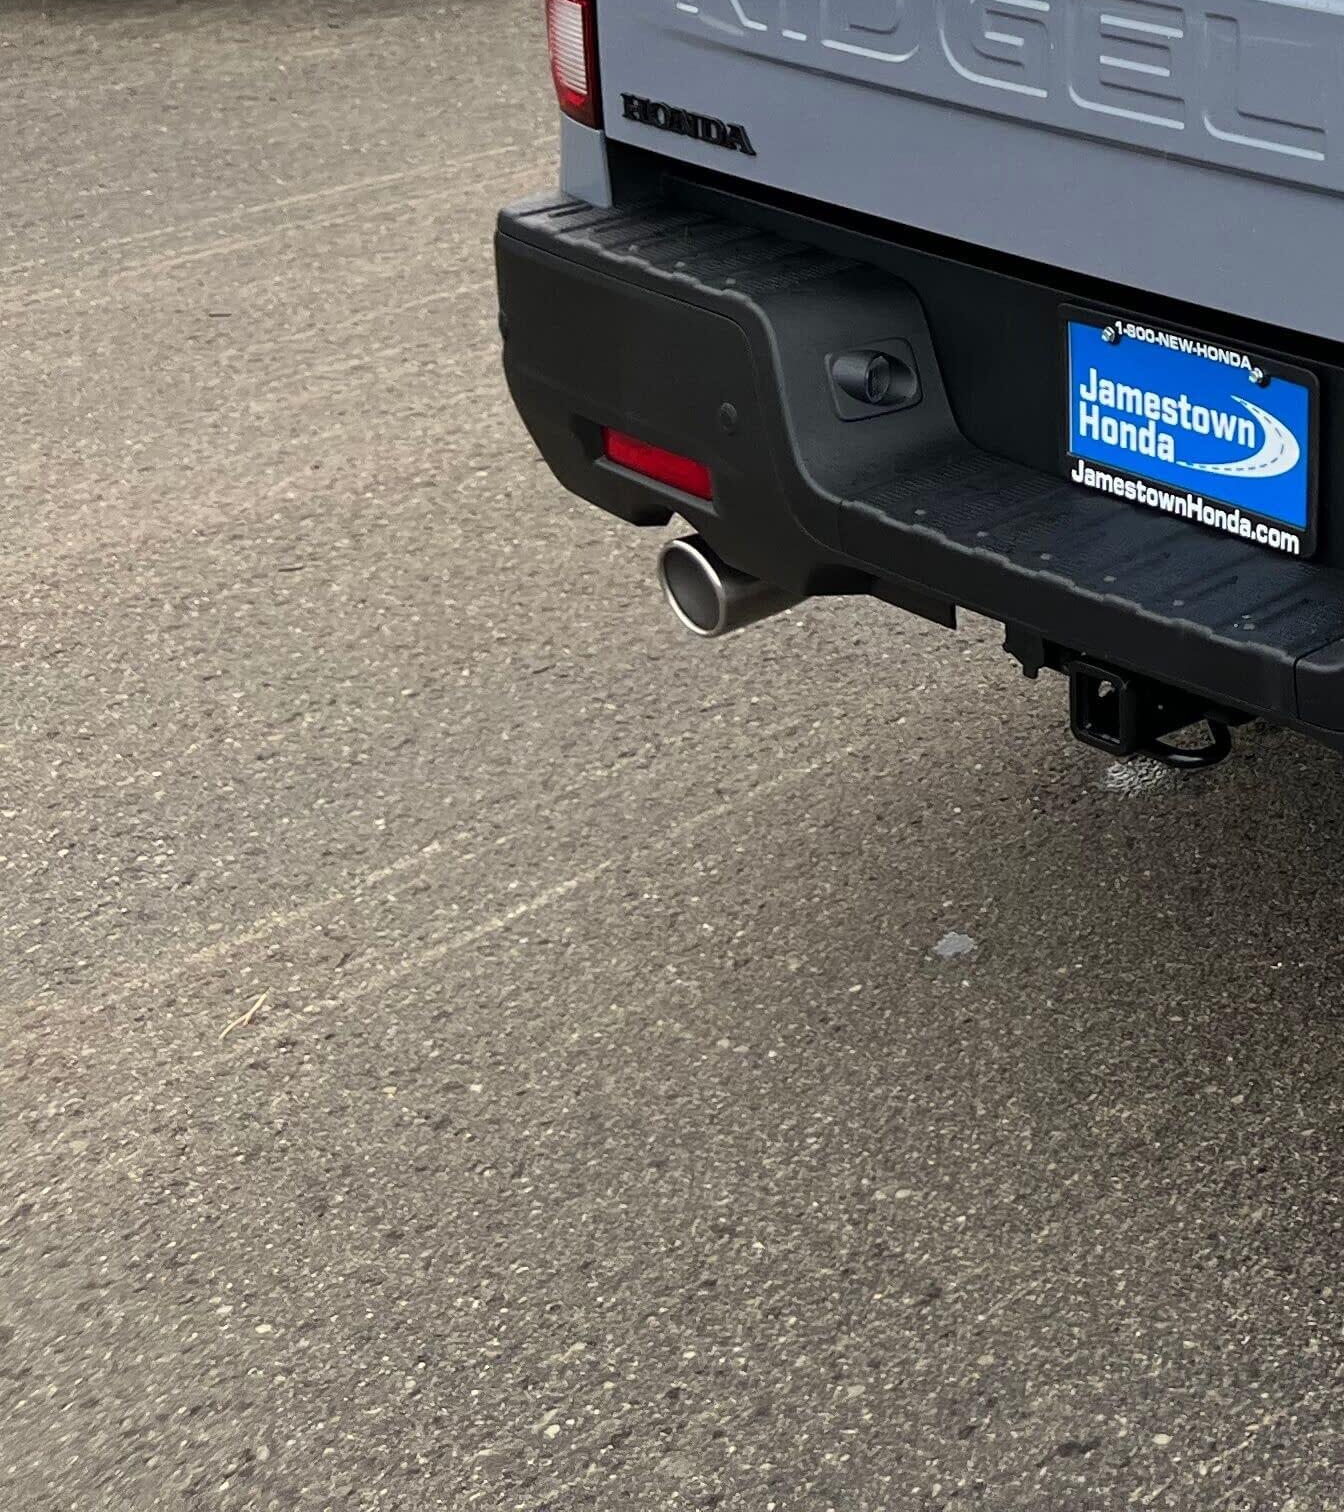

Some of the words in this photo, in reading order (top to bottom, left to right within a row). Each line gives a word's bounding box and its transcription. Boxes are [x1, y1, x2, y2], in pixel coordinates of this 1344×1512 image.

[620, 92, 757, 156] HONDA
[1114, 320, 1253, 371] 1-800-NEW-HONDA
[1079, 367, 1257, 449] Jamestown
[1079, 401, 1175, 464] Honda
[1071, 459, 1300, 555] JamestownHonda.com
